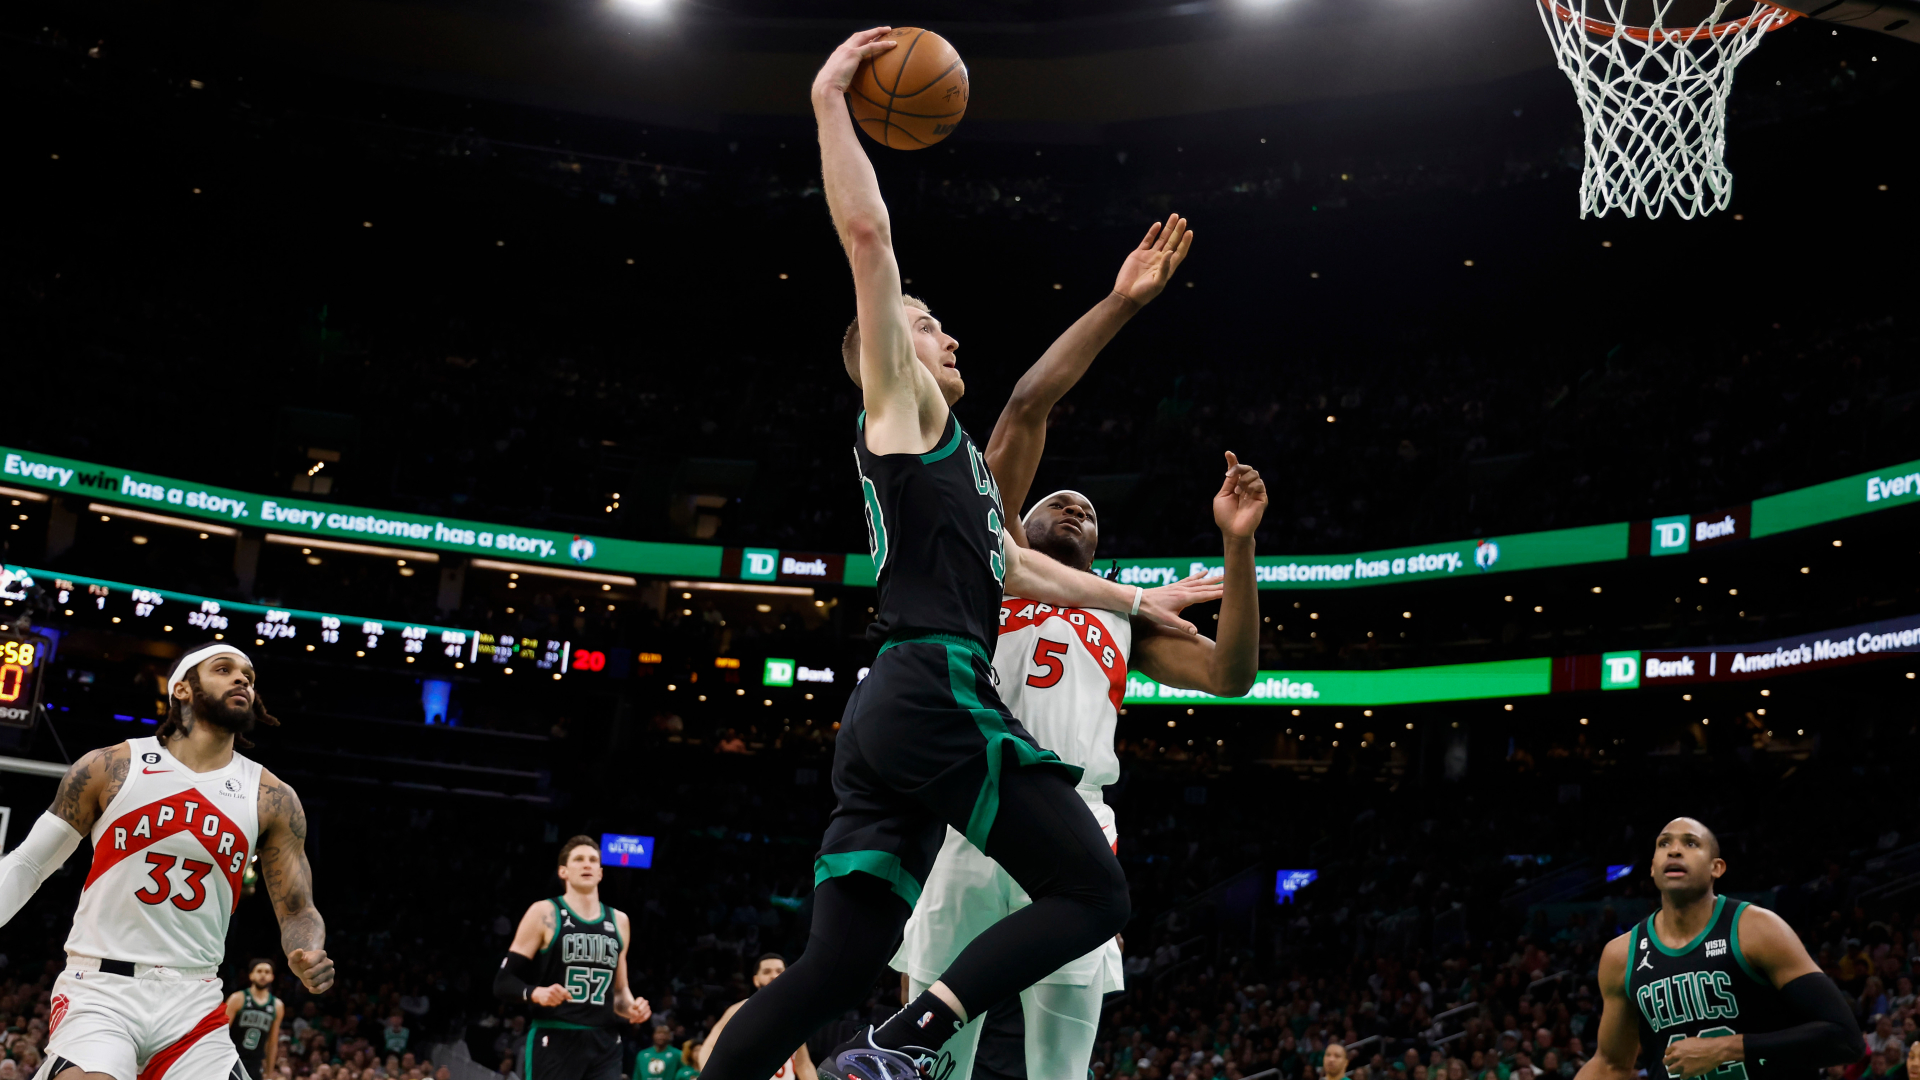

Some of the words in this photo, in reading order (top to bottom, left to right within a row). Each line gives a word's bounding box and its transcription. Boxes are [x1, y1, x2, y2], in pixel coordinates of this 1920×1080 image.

[4, 453, 74, 487] Every
[77, 471, 118, 491] win
[121, 475, 164, 501] has
[166, 487, 184, 504] a
[186, 491, 249, 518] story.
[260, 500, 325, 529] Every
[326, 511, 433, 539] customer
[434, 522, 476, 545] has
[477, 531, 493, 547] a
[495, 533, 556, 557] story.
[1655, 522, 1686, 548] TD
[1695, 515, 1735, 542] Bank
[747, 553, 775, 575] TD
[782, 557, 827, 576] Bank
[1120, 565, 1179, 585] story.
[1256, 563, 1354, 582] customer
[1354, 557, 1390, 579] has
[1391, 557, 1405, 575] a
[1407, 552, 1463, 573] story.
[96, 596, 105, 610] 1
[201, 600, 220, 614] FG
[321, 616, 341, 629] TO
[362, 621, 384, 635] STL
[401, 626, 428, 640] AST
[366, 634, 378, 648] 2
[999, 603, 1116, 669] RAPTORS
[572, 649, 606, 672] 20
[1025, 637, 1069, 689] 5
[1605, 657, 1638, 683] TD
[1645, 655, 1695, 678] Bank
[1730, 643, 1812, 673] America's
[1813, 636, 1855, 661] Most
[767, 661, 792, 681] TD
[796, 666, 834, 682] Bank
[1242, 678, 1320, 699] eltics.
[219, 790, 232, 798] Sun
[114, 801, 245, 874] RAPTORS
[607, 841, 645, 855] ULTRA
[134, 851, 213, 912] 33
[562, 932, 619, 969] CELTICS
[1640, 938, 1648, 949] 6
[1705, 939, 1726, 951] VISTA
[1706, 946, 1727, 958] PRINT
[564, 965, 613, 1005] 57
[1636, 970, 1740, 1033] CELTICS
[242, 1027, 261, 1050] 9
